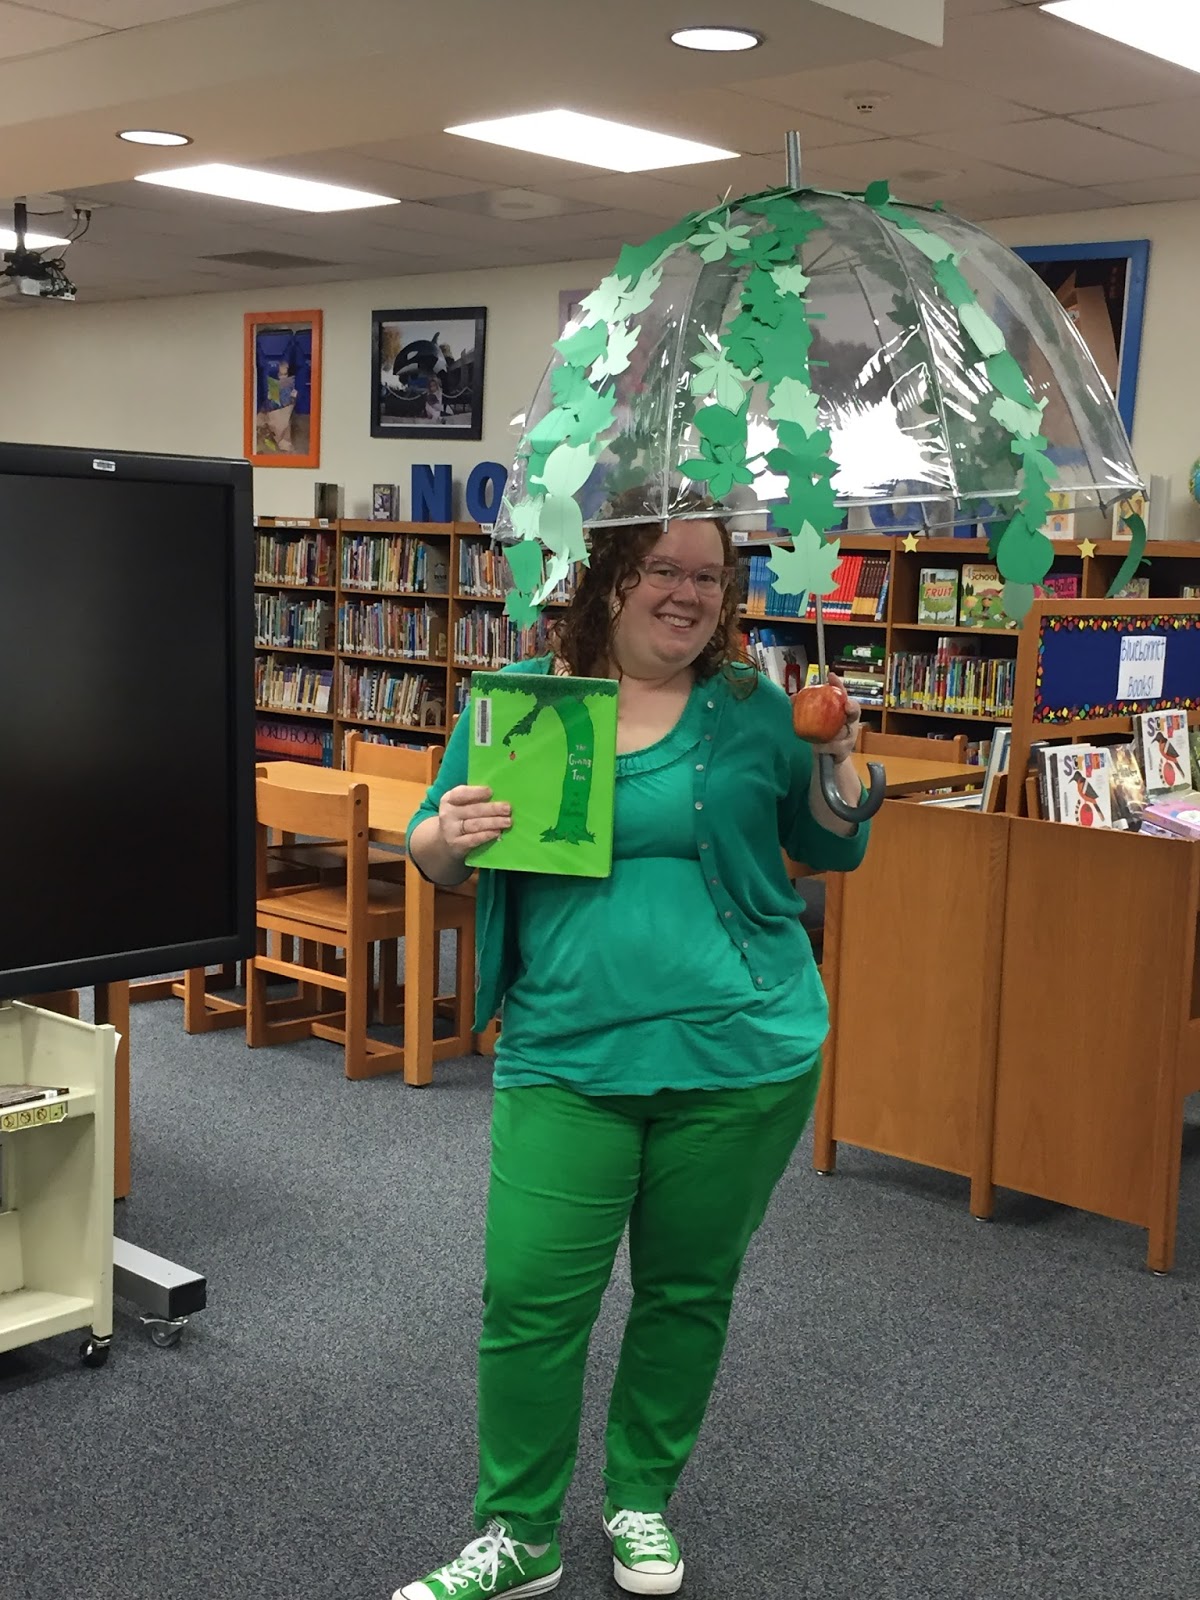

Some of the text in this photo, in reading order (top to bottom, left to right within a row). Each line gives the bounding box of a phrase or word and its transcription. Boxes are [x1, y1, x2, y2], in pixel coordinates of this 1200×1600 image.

[925, 587, 953, 597] FRUIT
[1121, 639, 1165, 661] Bluebonnet
[290, 729, 322, 745] BOOK
